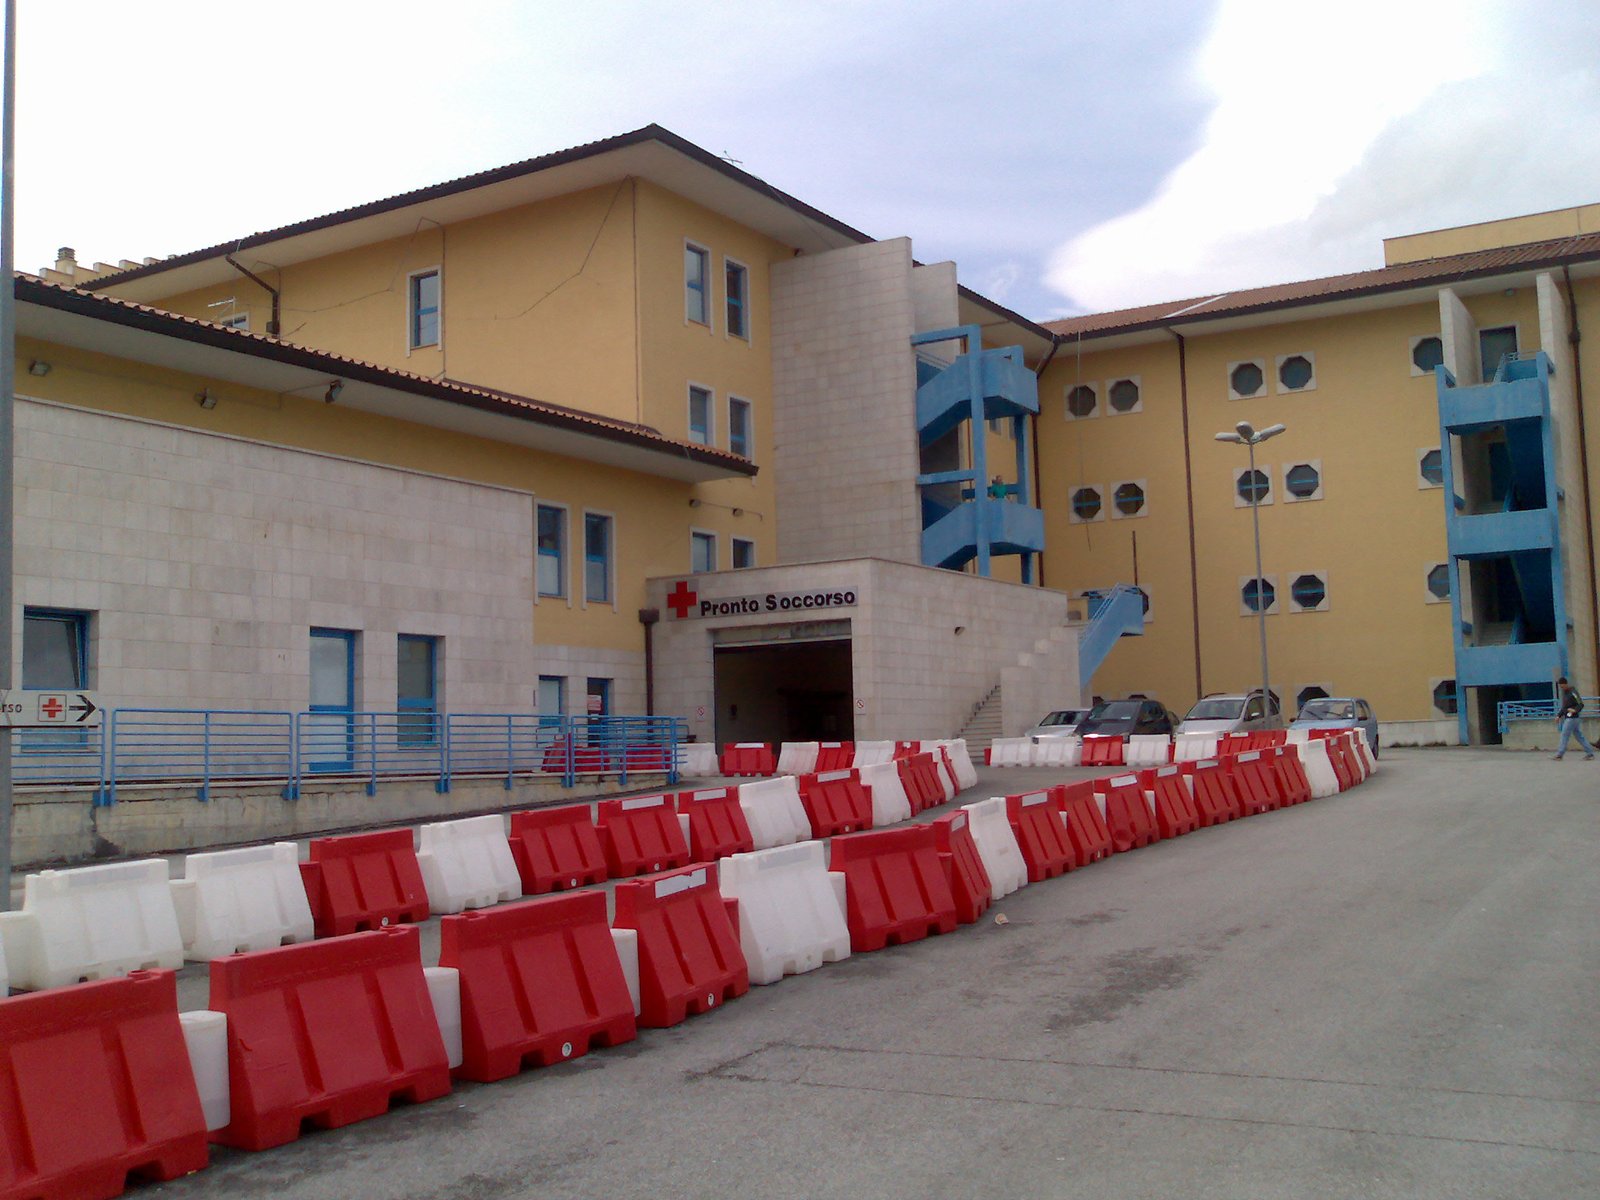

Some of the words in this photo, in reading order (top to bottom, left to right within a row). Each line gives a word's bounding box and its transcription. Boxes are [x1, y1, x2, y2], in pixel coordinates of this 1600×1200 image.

[701, 599, 759, 616] Pronto
[766, 591, 855, 610] Soccorso
[0, 703, 22, 713] rso
